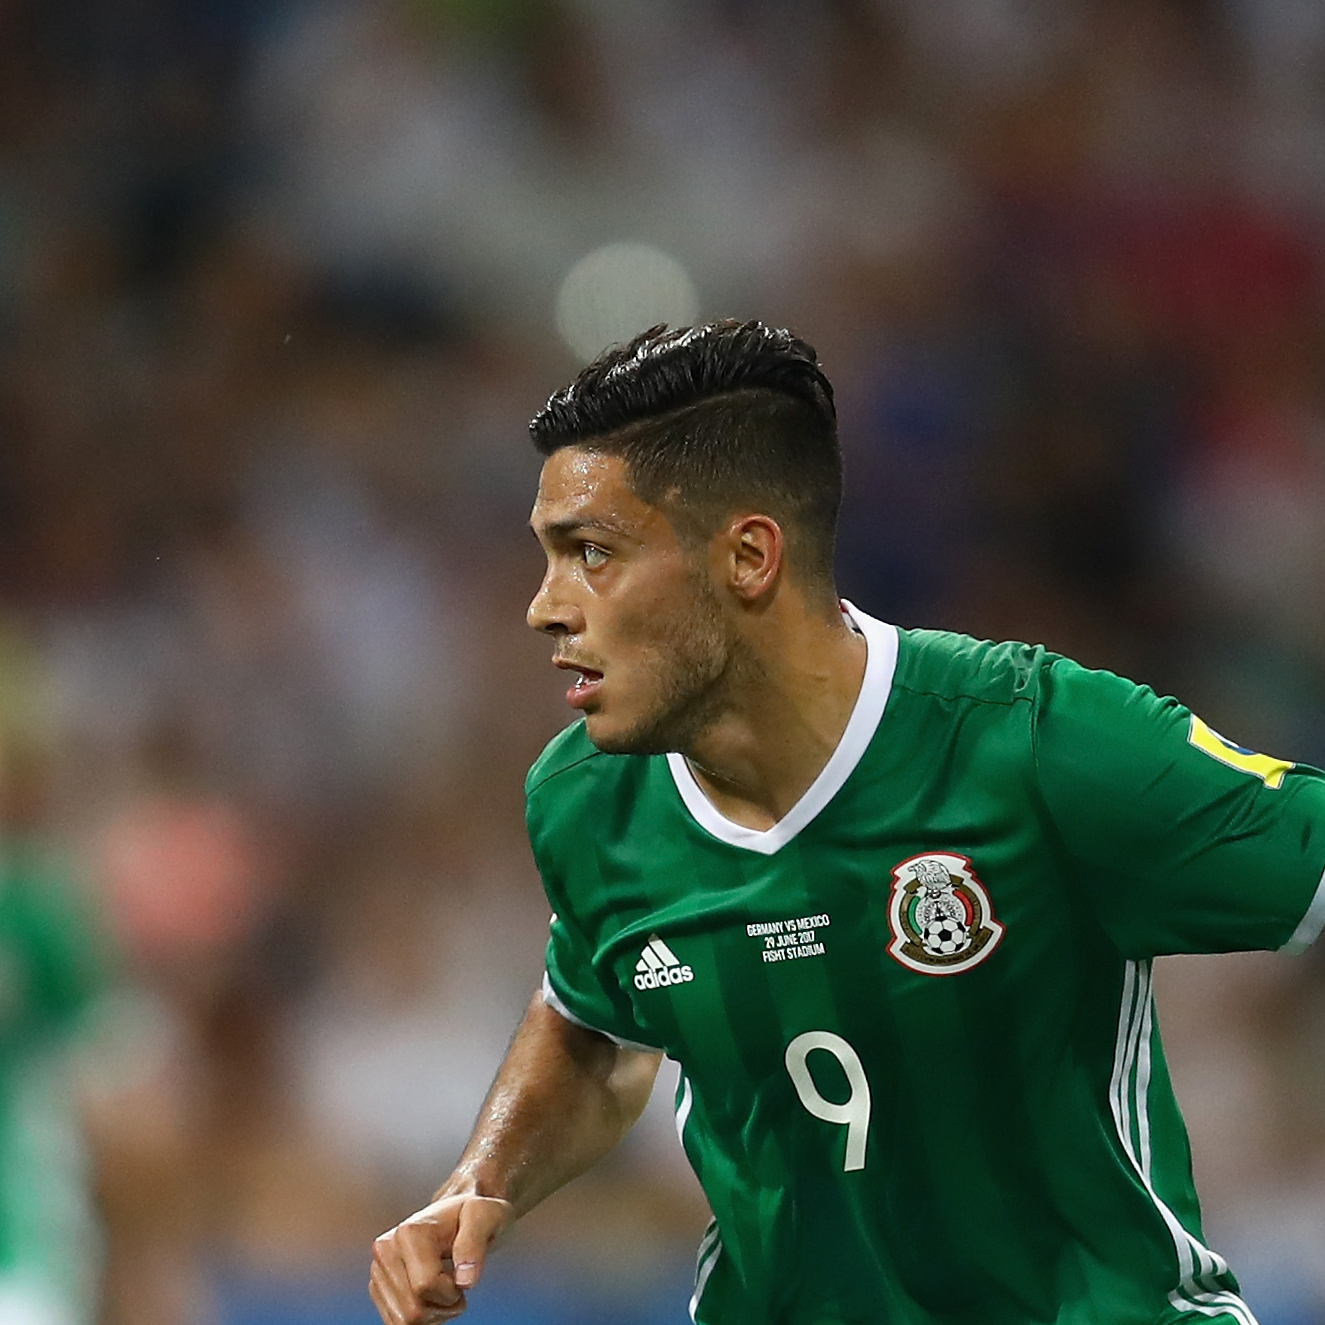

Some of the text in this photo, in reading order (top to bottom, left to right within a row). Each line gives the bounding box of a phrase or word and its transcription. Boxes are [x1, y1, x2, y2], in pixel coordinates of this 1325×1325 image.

[747, 914, 830, 936] GERMANY VS MEXICO
[764, 930, 815, 948] 29 JUNE 2017
[762, 943, 826, 962] FISHT STADIUM
[634, 965, 694, 990] adidas
[785, 1030, 871, 1172] 9
